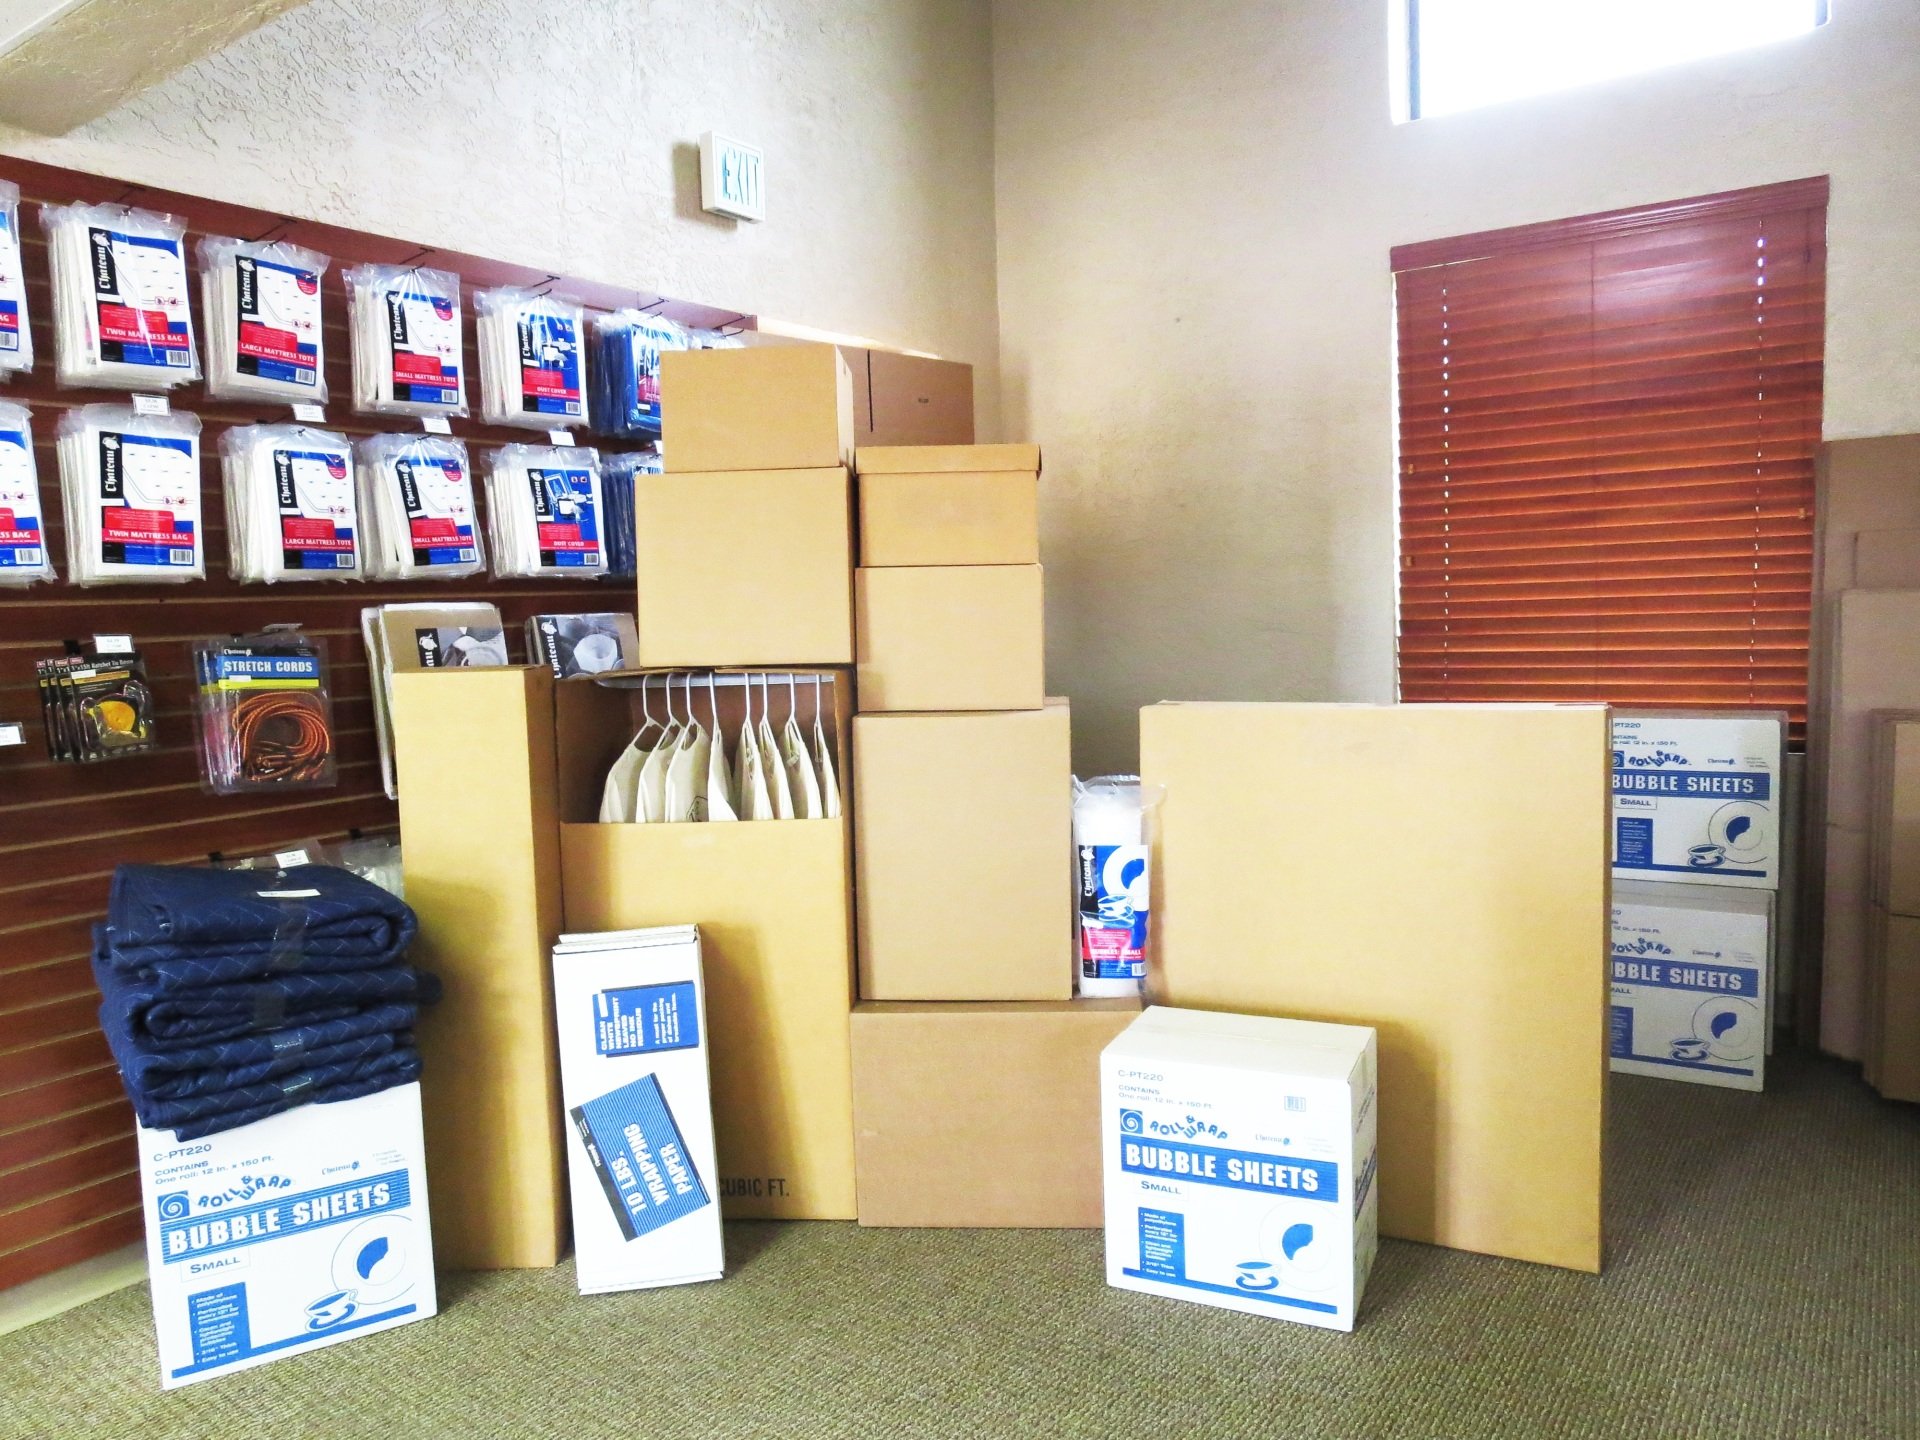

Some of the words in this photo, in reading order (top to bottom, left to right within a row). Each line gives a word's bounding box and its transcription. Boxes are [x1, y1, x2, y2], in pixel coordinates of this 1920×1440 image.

[721, 145, 759, 208] EXIT
[0, 314, 9, 322] AG
[105, 327, 126, 336] TWIN
[128, 330, 165, 340] MARESS
[167, 333, 183, 342] BAG
[241, 342, 262, 353] LARGE
[264, 346, 297, 359] MATTRESS
[299, 352, 315, 363] TOTE
[395, 371, 413, 380] SMALL
[105, 450, 118, 492] Chateau
[12, 531, 31, 539] BAG
[108, 529, 129, 537] TWIN
[130, 531, 170, 540] MATTRESS
[306, 538, 335, 546] MATTRESS
[224, 660, 272, 673] STRETCH
[275, 661, 313, 673] CORDS
[1653, 753, 1688, 768] WRAP
[1612, 774, 1679, 791] BUBBLE
[1687, 776, 1754, 794] SHEETS
[1612, 960, 1660, 982] BBLE
[1669, 967, 1742, 991] SHEETS
[612, 996, 622, 1049] NEWSPRINT
[621, 1014, 629, 1049] LEAVES
[606, 1022, 614, 1050] WHITE
[630, 1033, 637, 1048] NO
[1118, 1069, 1164, 1082] C-PT220
[1118, 1084, 1161, 1095] CONTAINS
[1149, 1120, 1185, 1136] ROLL
[1183, 1121, 1229, 1139] WRAP
[153, 1143, 212, 1162] C-PT220
[154, 1160, 209, 1177] CONTAINS
[155, 1176, 176, 1185] One
[202, 1168, 214, 1176] 12
[241, 1158, 259, 1168] 150
[611, 1150, 637, 1191] LBS.
[623, 1122, 670, 1207] WRAPPING
[660, 1142, 693, 1196] PAPER
[1125, 1142, 1217, 1179] BUBBLE
[1226, 1158, 1319, 1193] SHEETS
[198, 1188, 241, 1207] ROLL
[239, 1175, 292, 1201] WRAP
[718, 1178, 763, 1197] CUBIC
[767, 1178, 790, 1197] FT.
[626, 1191, 648, 1216] 10
[168, 1208, 281, 1256] BUBBLE
[292, 1183, 391, 1226] SHEETS
